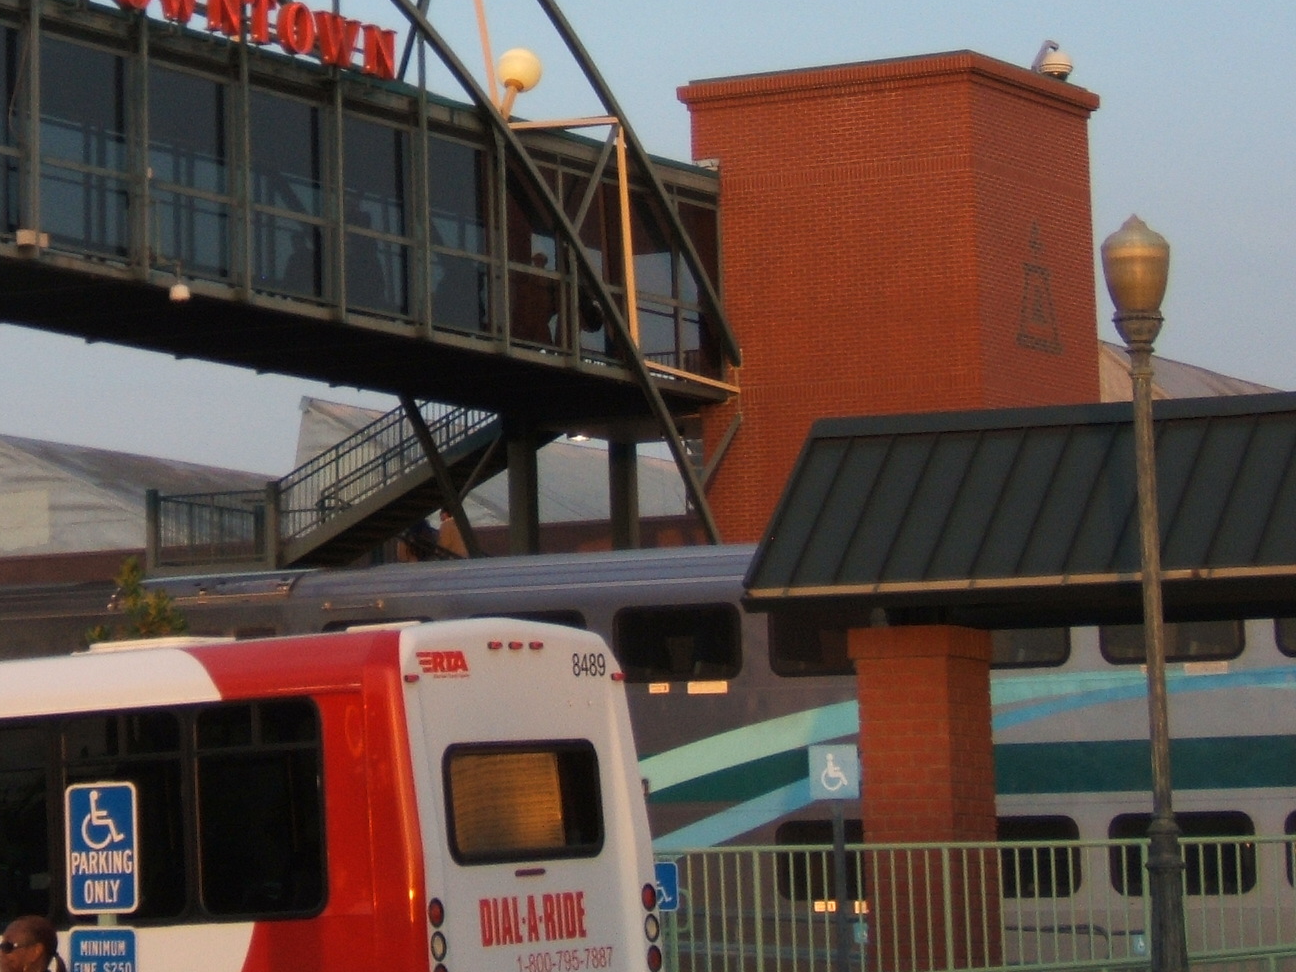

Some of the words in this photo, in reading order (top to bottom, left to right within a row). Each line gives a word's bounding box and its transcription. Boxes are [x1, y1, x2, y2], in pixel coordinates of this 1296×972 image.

[428, 650, 469, 673] RTA
[572, 652, 606, 677] 8489
[71, 849, 133, 875] PARKING
[84, 879, 120, 904] ONLY
[80, 940, 126, 957] MINIMUM
[516, 946, 613, 972] 1-800-795-7887
[74, 962, 97, 972] FINE
[104, 961, 132, 972] $250
